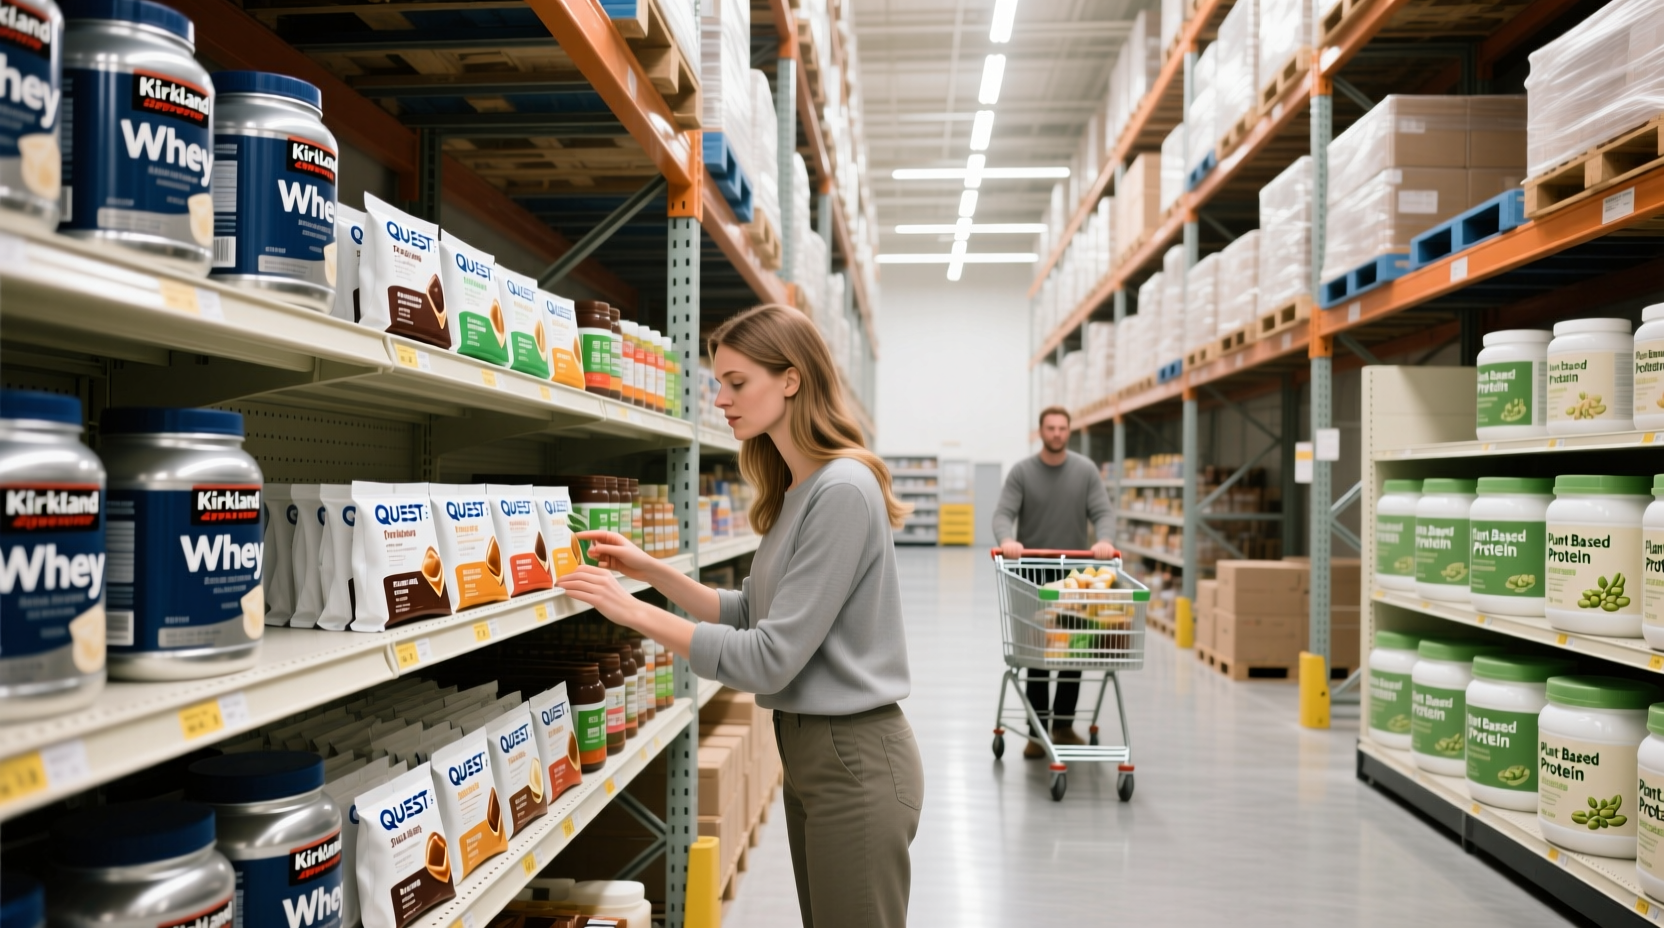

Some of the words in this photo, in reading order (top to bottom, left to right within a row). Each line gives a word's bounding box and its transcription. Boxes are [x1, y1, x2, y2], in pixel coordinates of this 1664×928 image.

[139, 76, 209, 115] Kirkland
[120, 119, 213, 187] Whey
[6, 490, 99, 515] Kirkland
[198, 491, 260, 511] Kirkland
[375, 504, 424, 525] QUEST
[1571, 534, 1610, 548] Based
[180, 534, 264, 580] Whey
[1548, 548, 1591, 565] Protein
[0, 543, 105, 599] Whey
[1562, 746, 1600, 766] Based
[1541, 757, 1585, 782] Protein
[380, 789, 429, 831] QUEST
